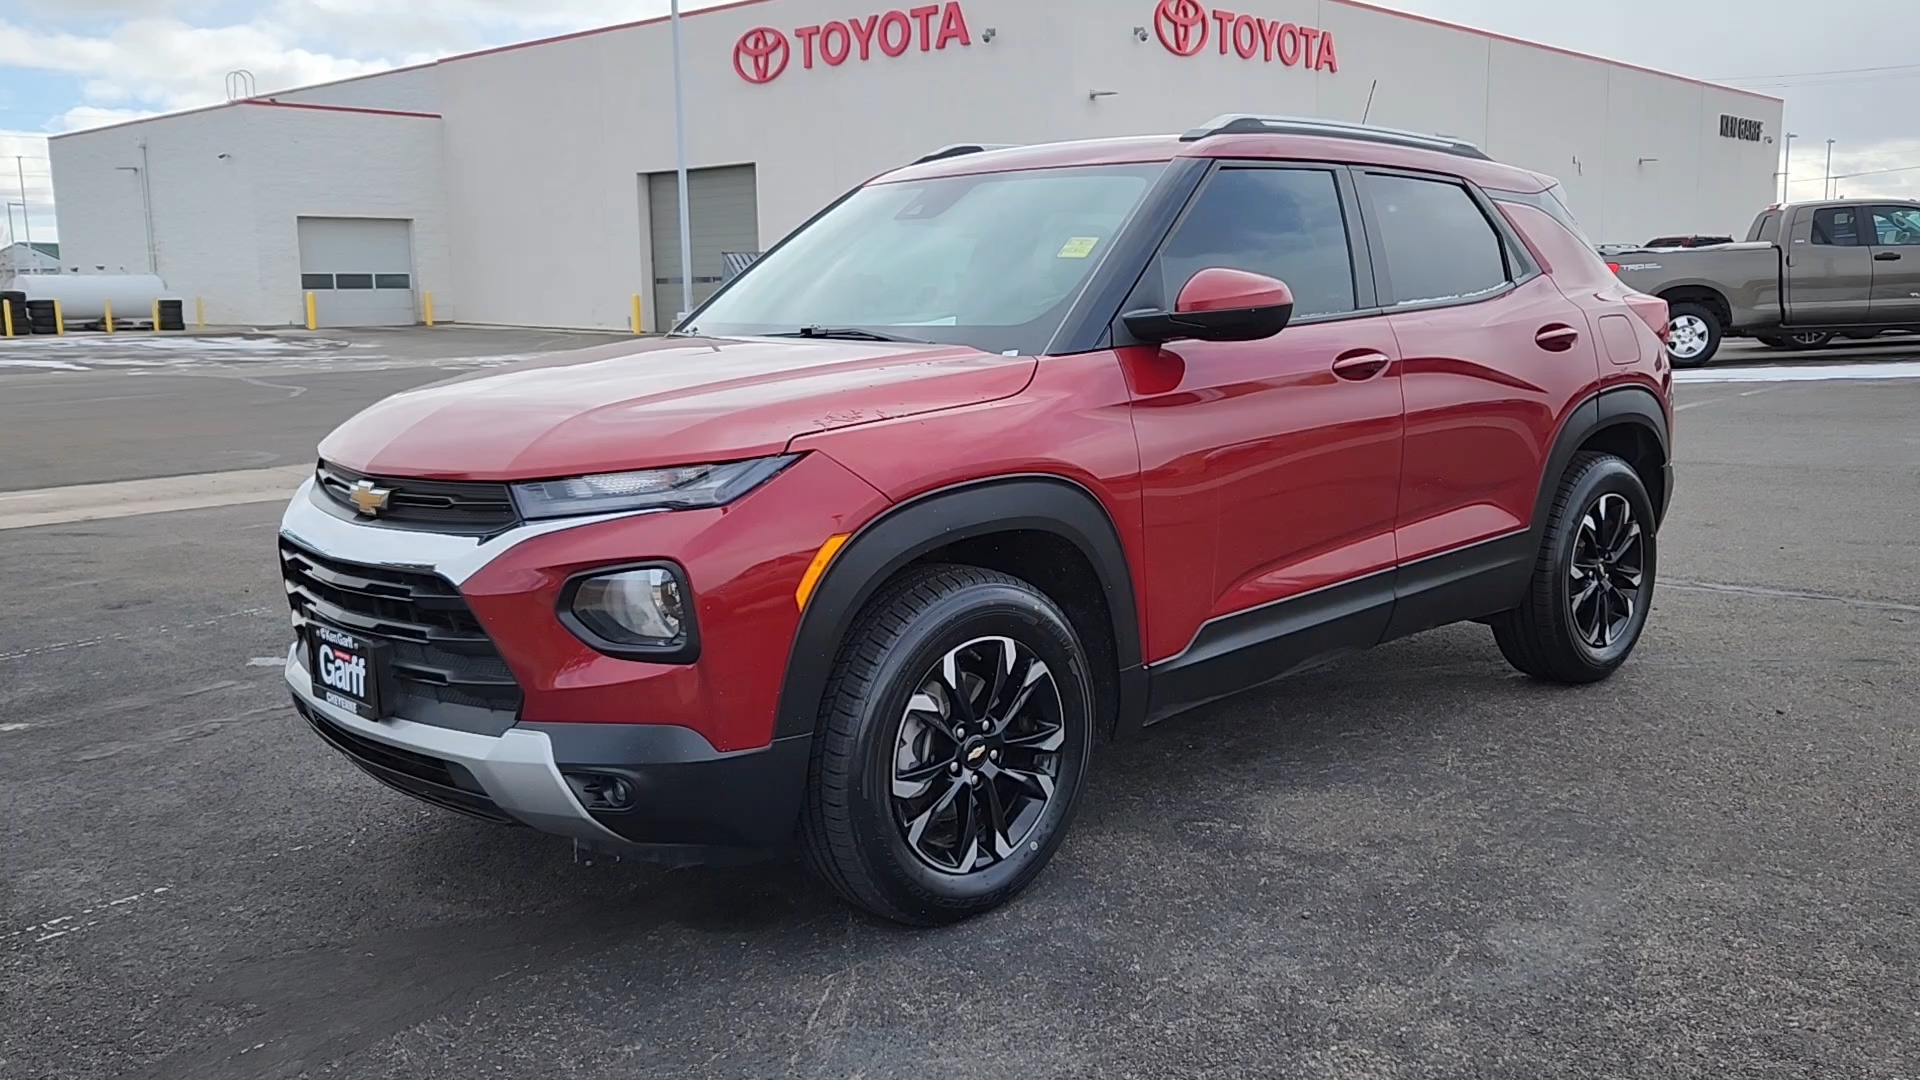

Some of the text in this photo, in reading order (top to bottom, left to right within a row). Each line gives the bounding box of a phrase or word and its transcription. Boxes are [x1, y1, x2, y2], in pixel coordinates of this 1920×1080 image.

[794, 1, 971, 69] TOYOTA
[1212, 9, 1338, 73] TOYOTA
[319, 644, 366, 698] Garff
